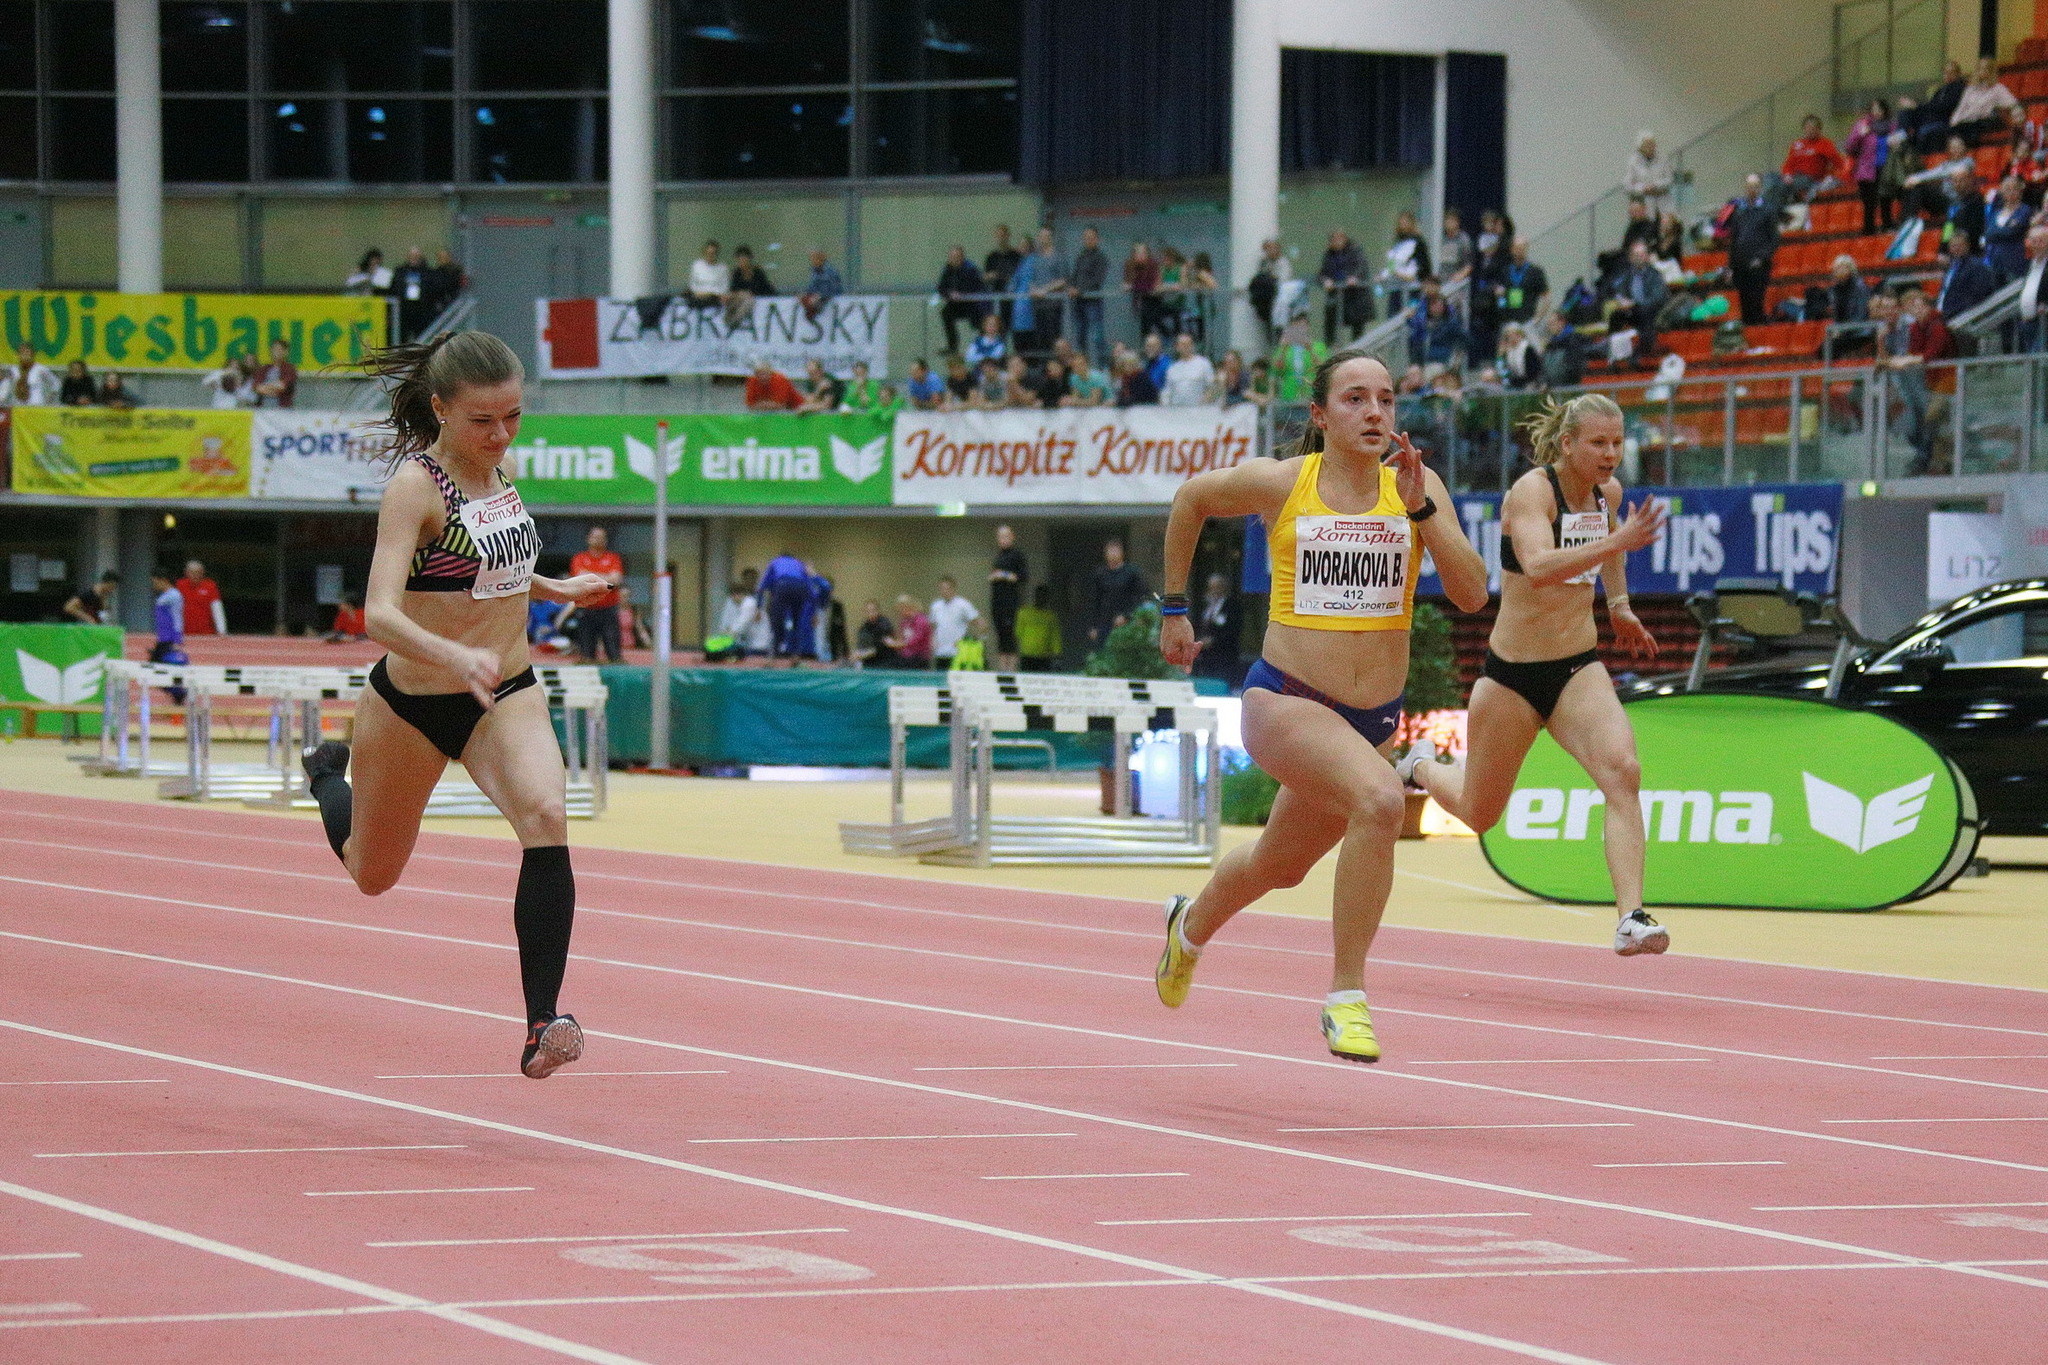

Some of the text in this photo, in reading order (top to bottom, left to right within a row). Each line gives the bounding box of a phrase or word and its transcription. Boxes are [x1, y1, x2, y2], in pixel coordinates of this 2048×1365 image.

[4, 295, 374, 366] Wiesbauer
[702, 438, 821, 480] erima
[901, 424, 1250, 487] Kornspitz Kornspitz
[1309, 527, 1406, 545] Kornspitz
[1650, 496, 1725, 591] Tips
[1752, 493, 1832, 590] Tips
[513, 564, 526, 577] 211
[1302, 550, 1388, 587] DVORAKOVA
[1392, 553, 1403, 586] B.
[1343, 590, 1364, 600] 412
[1505, 788, 1774, 844] erma
